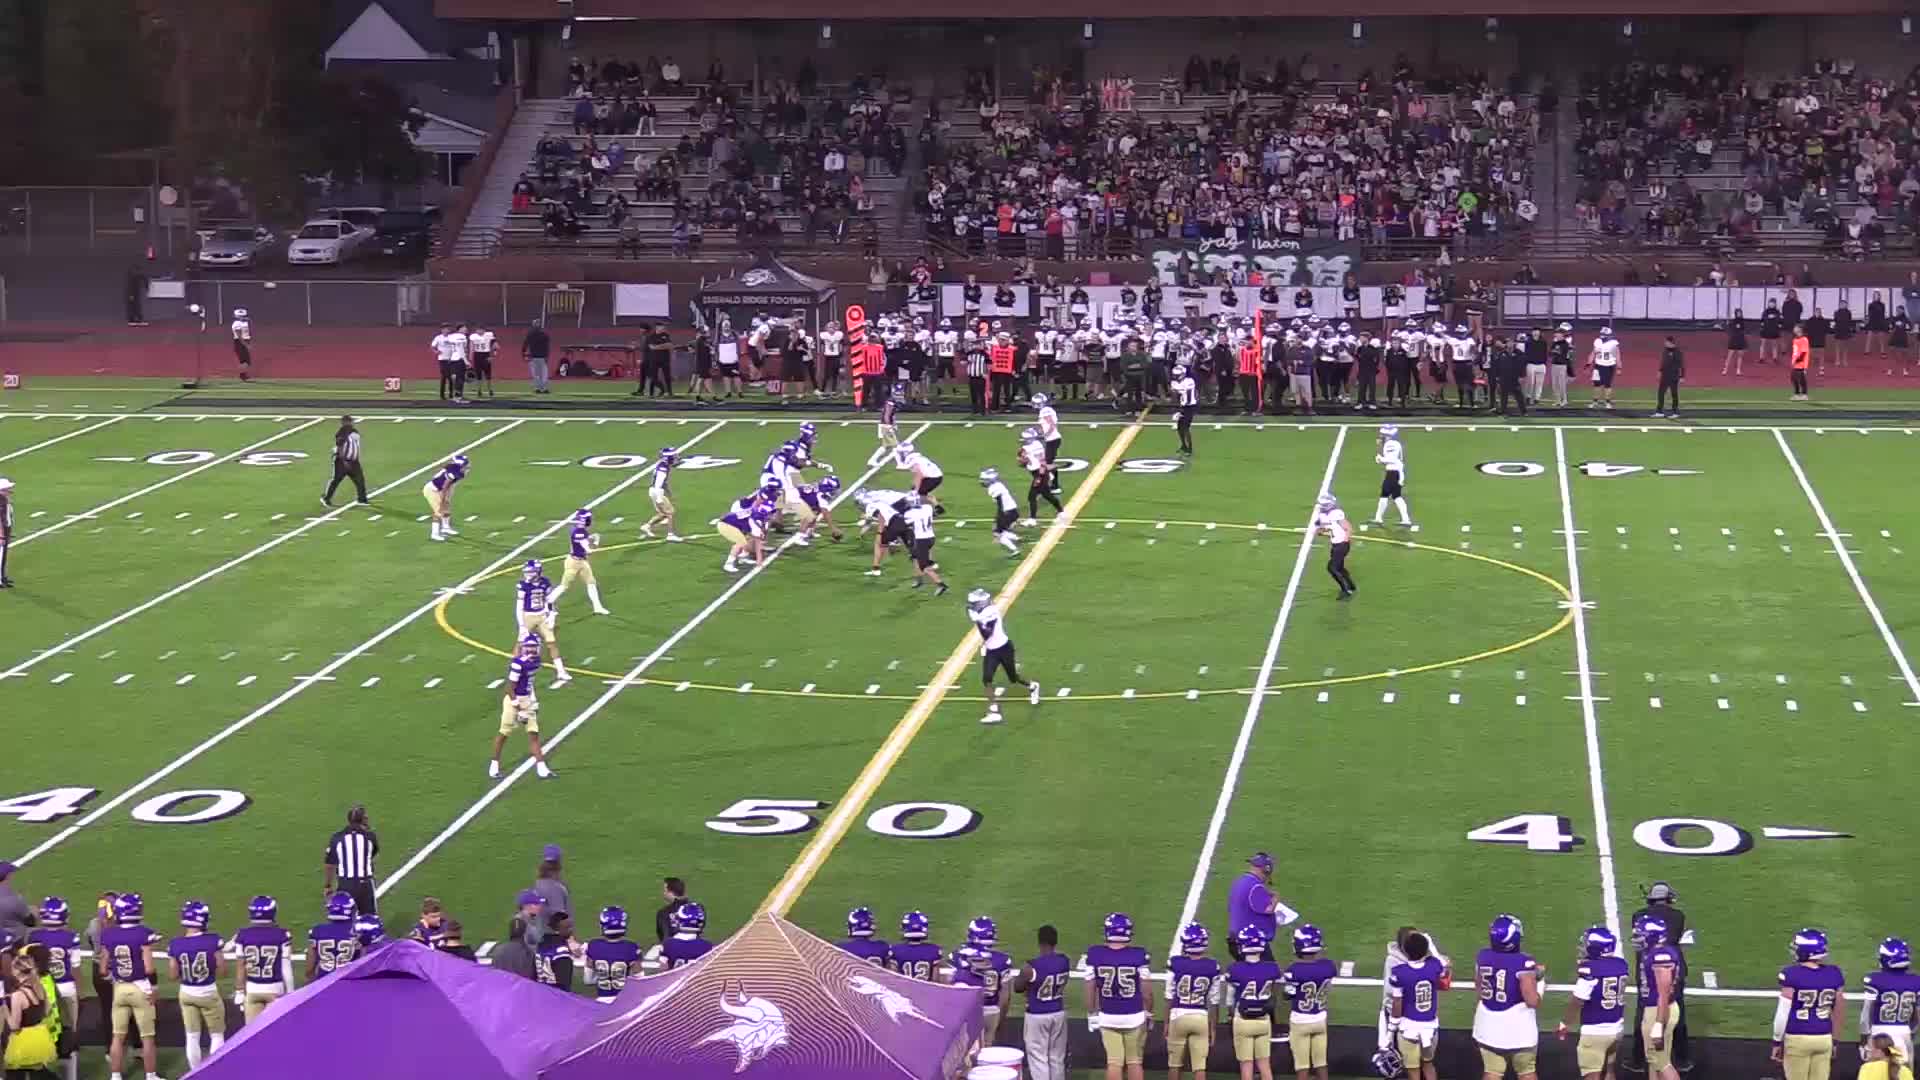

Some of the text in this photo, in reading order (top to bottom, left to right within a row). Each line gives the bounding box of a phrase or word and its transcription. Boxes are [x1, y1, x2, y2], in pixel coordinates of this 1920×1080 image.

[769, 295, 811, 305] FOOTBALL
[384, 377, 400, 391] 30
[178, 951, 210, 984] 14
[244, 945, 279, 979] 27
[317, 939, 355, 972] 52
[1036, 972, 1069, 1002] 47
[1097, 966, 1137, 998] 75
[1176, 974, 1211, 1005] 42
[1241, 980, 1274, 1001] 44
[1478, 965, 1508, 1003] 51
